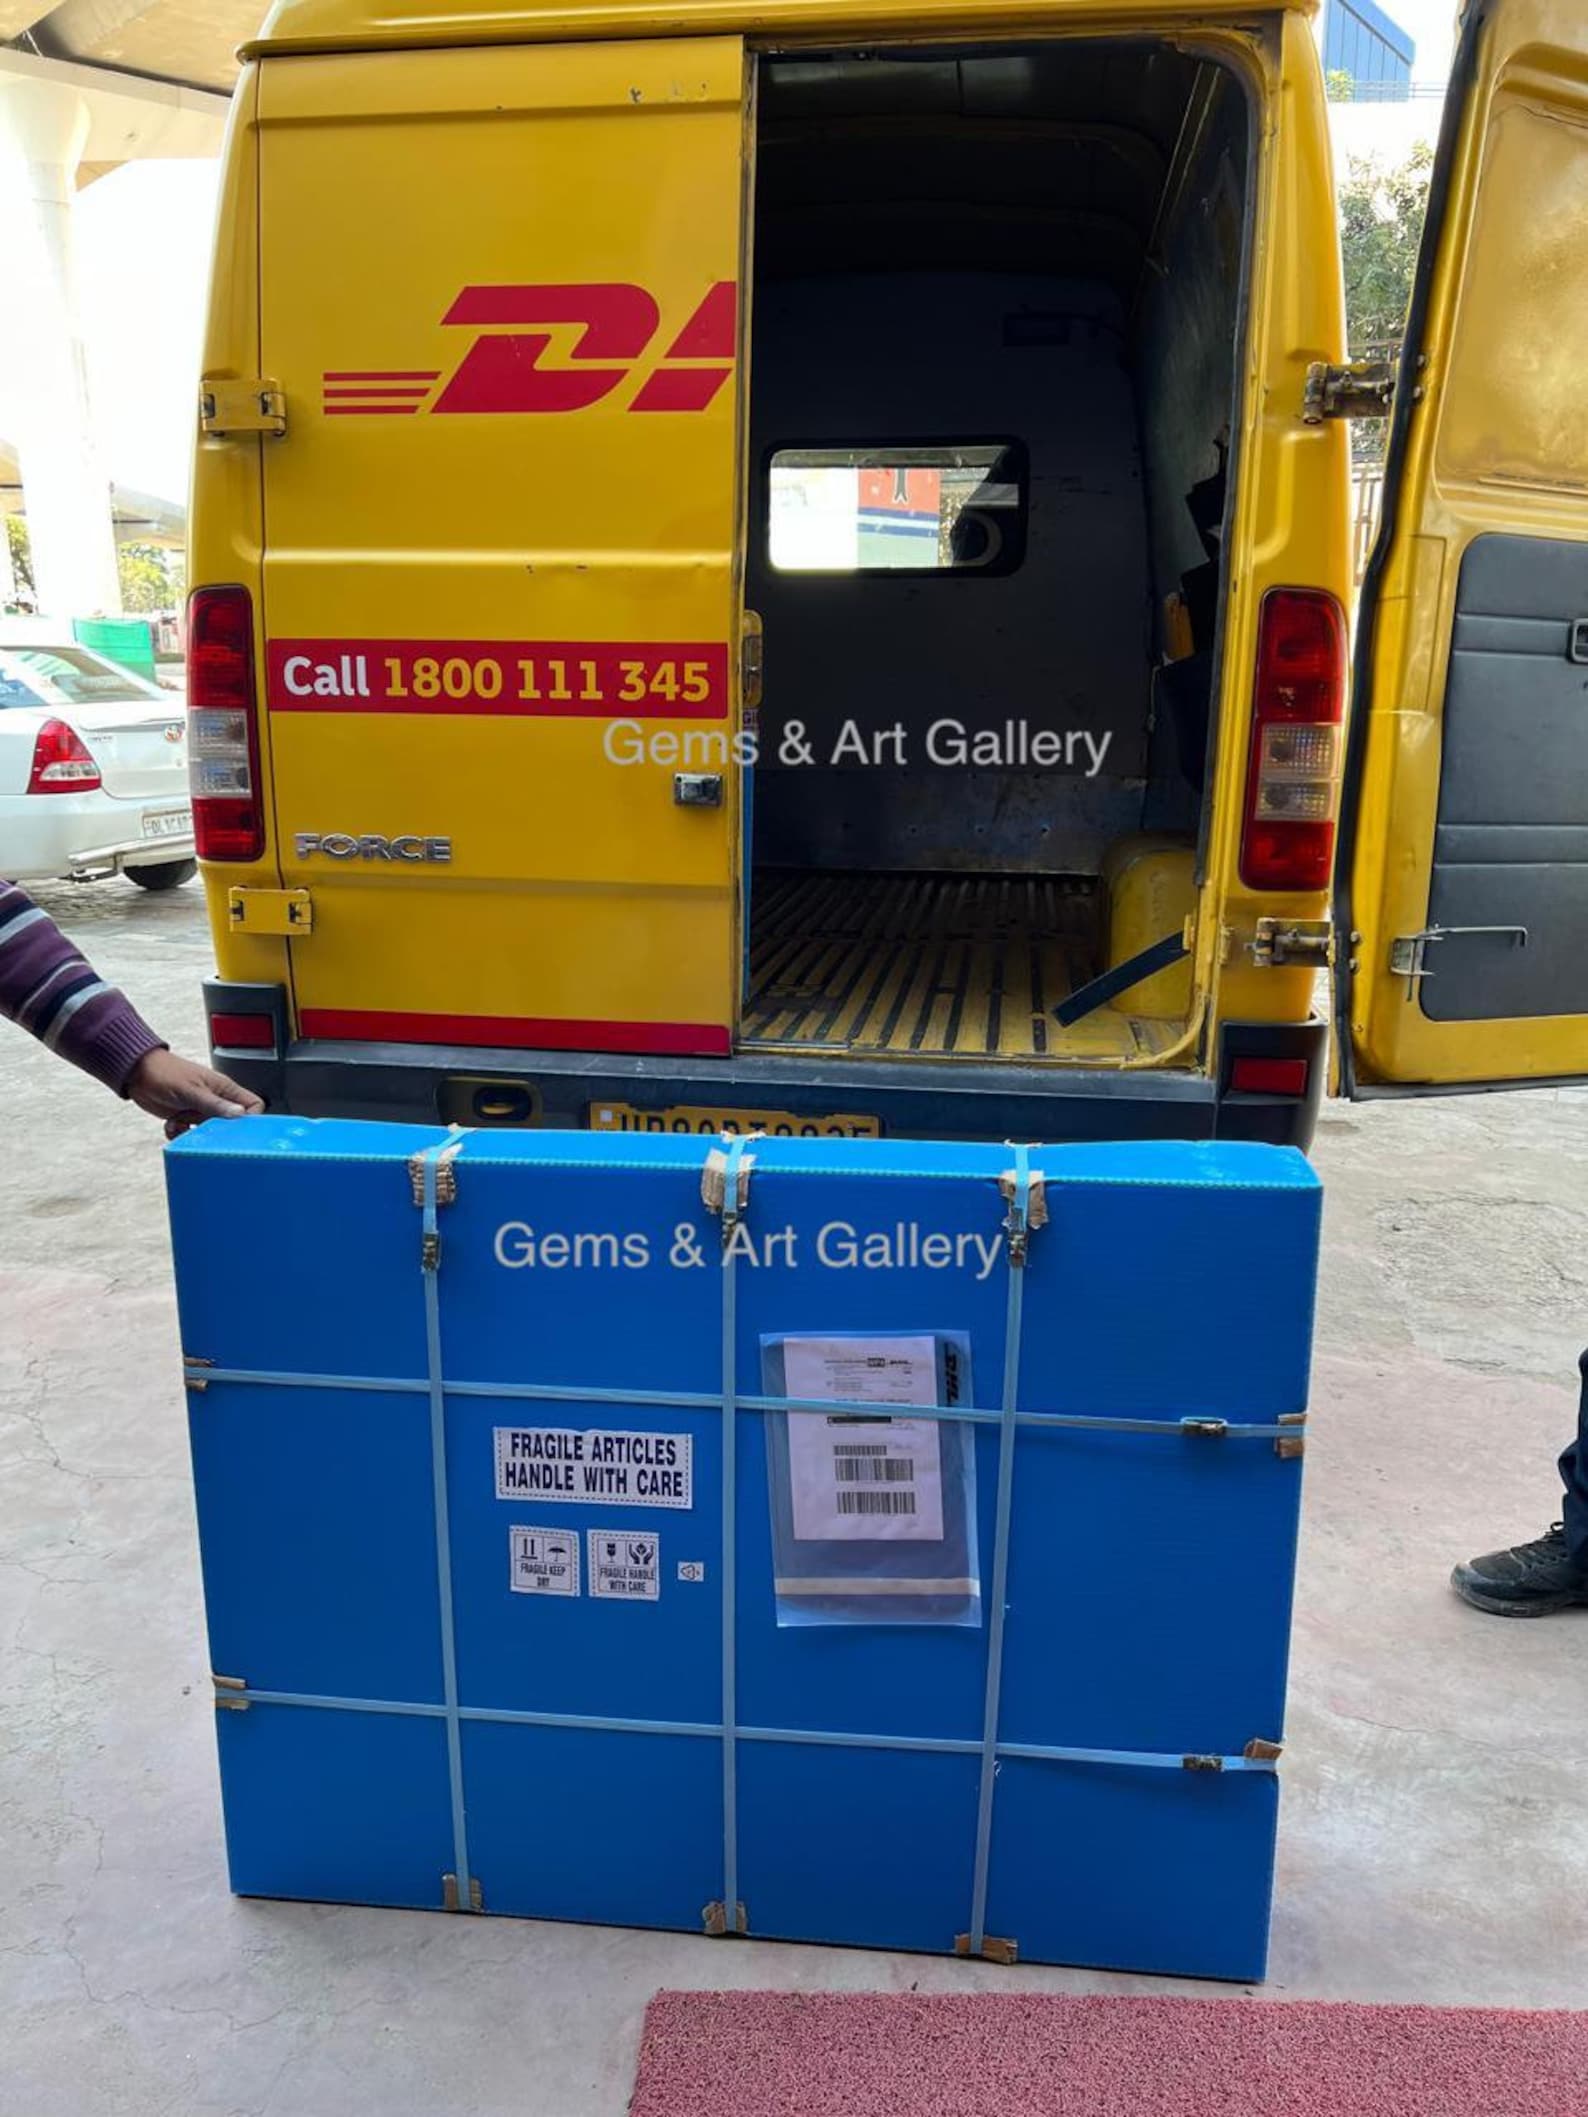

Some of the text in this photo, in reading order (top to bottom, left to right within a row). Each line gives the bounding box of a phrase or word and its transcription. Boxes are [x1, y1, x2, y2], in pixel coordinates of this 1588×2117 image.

[283, 655, 711, 702] Call 1800 111 345
[294, 832, 453, 863] FORCE
[510, 1431, 677, 1466] FRAGILE ARTICLES
[504, 1462, 684, 1497] HANDLE WITH CARE
[520, 1562, 567, 1577] FRAGILE KEEP
[600, 1567, 627, 1579] FRAGILE
[609, 1579, 647, 1593] WITH CARE
